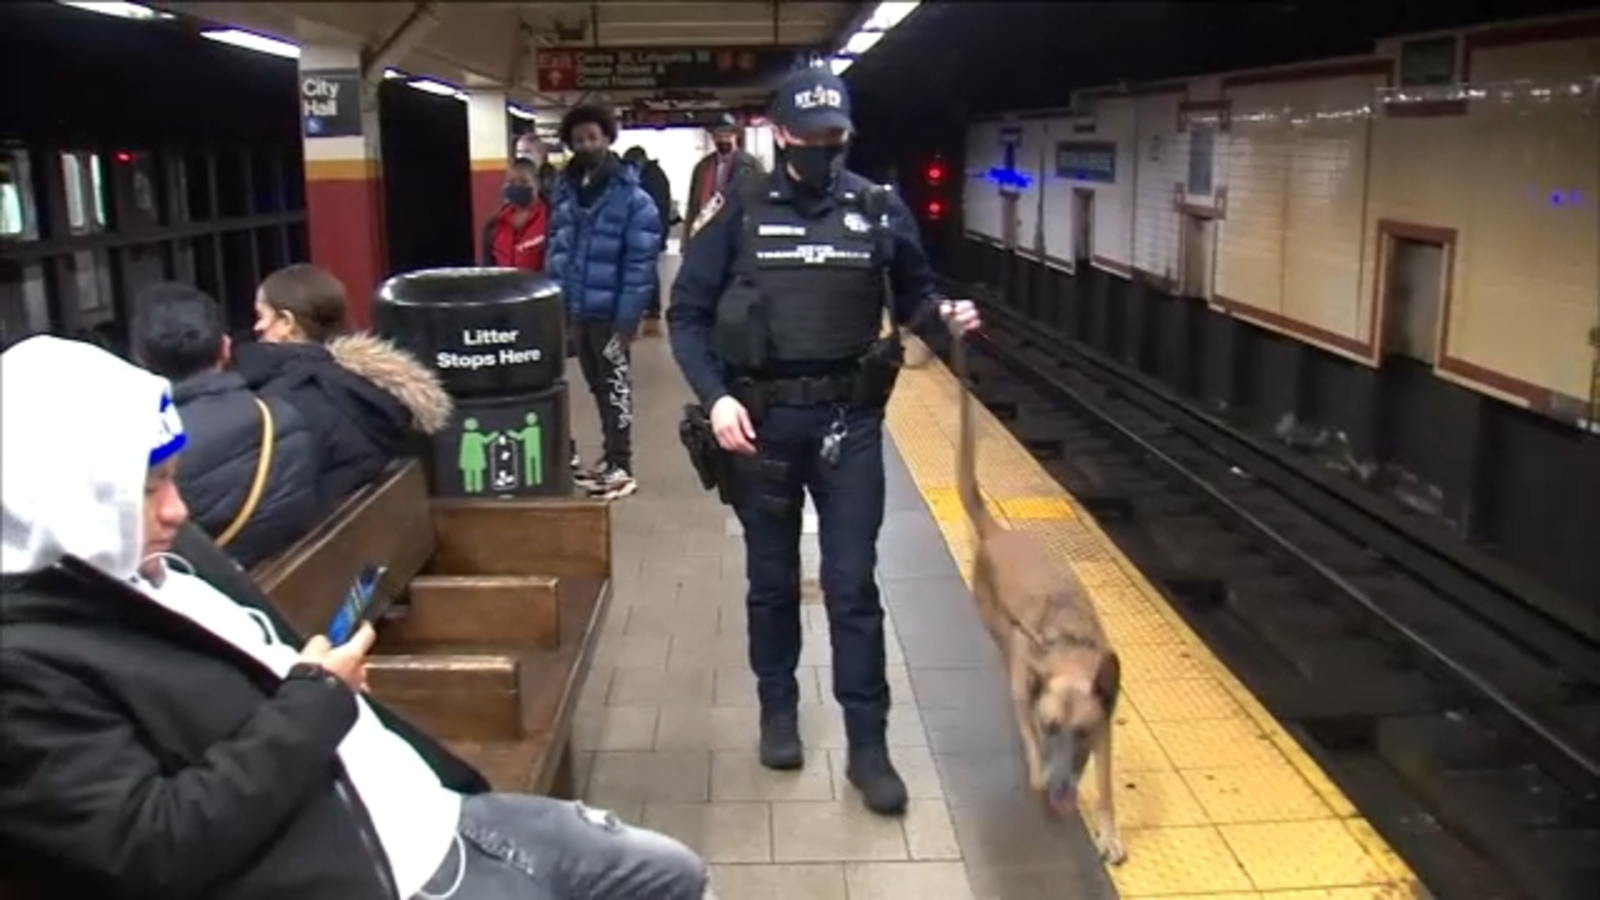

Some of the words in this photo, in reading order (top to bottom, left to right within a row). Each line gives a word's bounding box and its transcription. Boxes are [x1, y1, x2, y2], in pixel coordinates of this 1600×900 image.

[302, 78, 339, 99] City
[303, 99, 337, 116] Hall
[463, 329, 519, 346] Litter
[437, 352, 496, 370] Stops
[499, 349, 540, 365] Here
